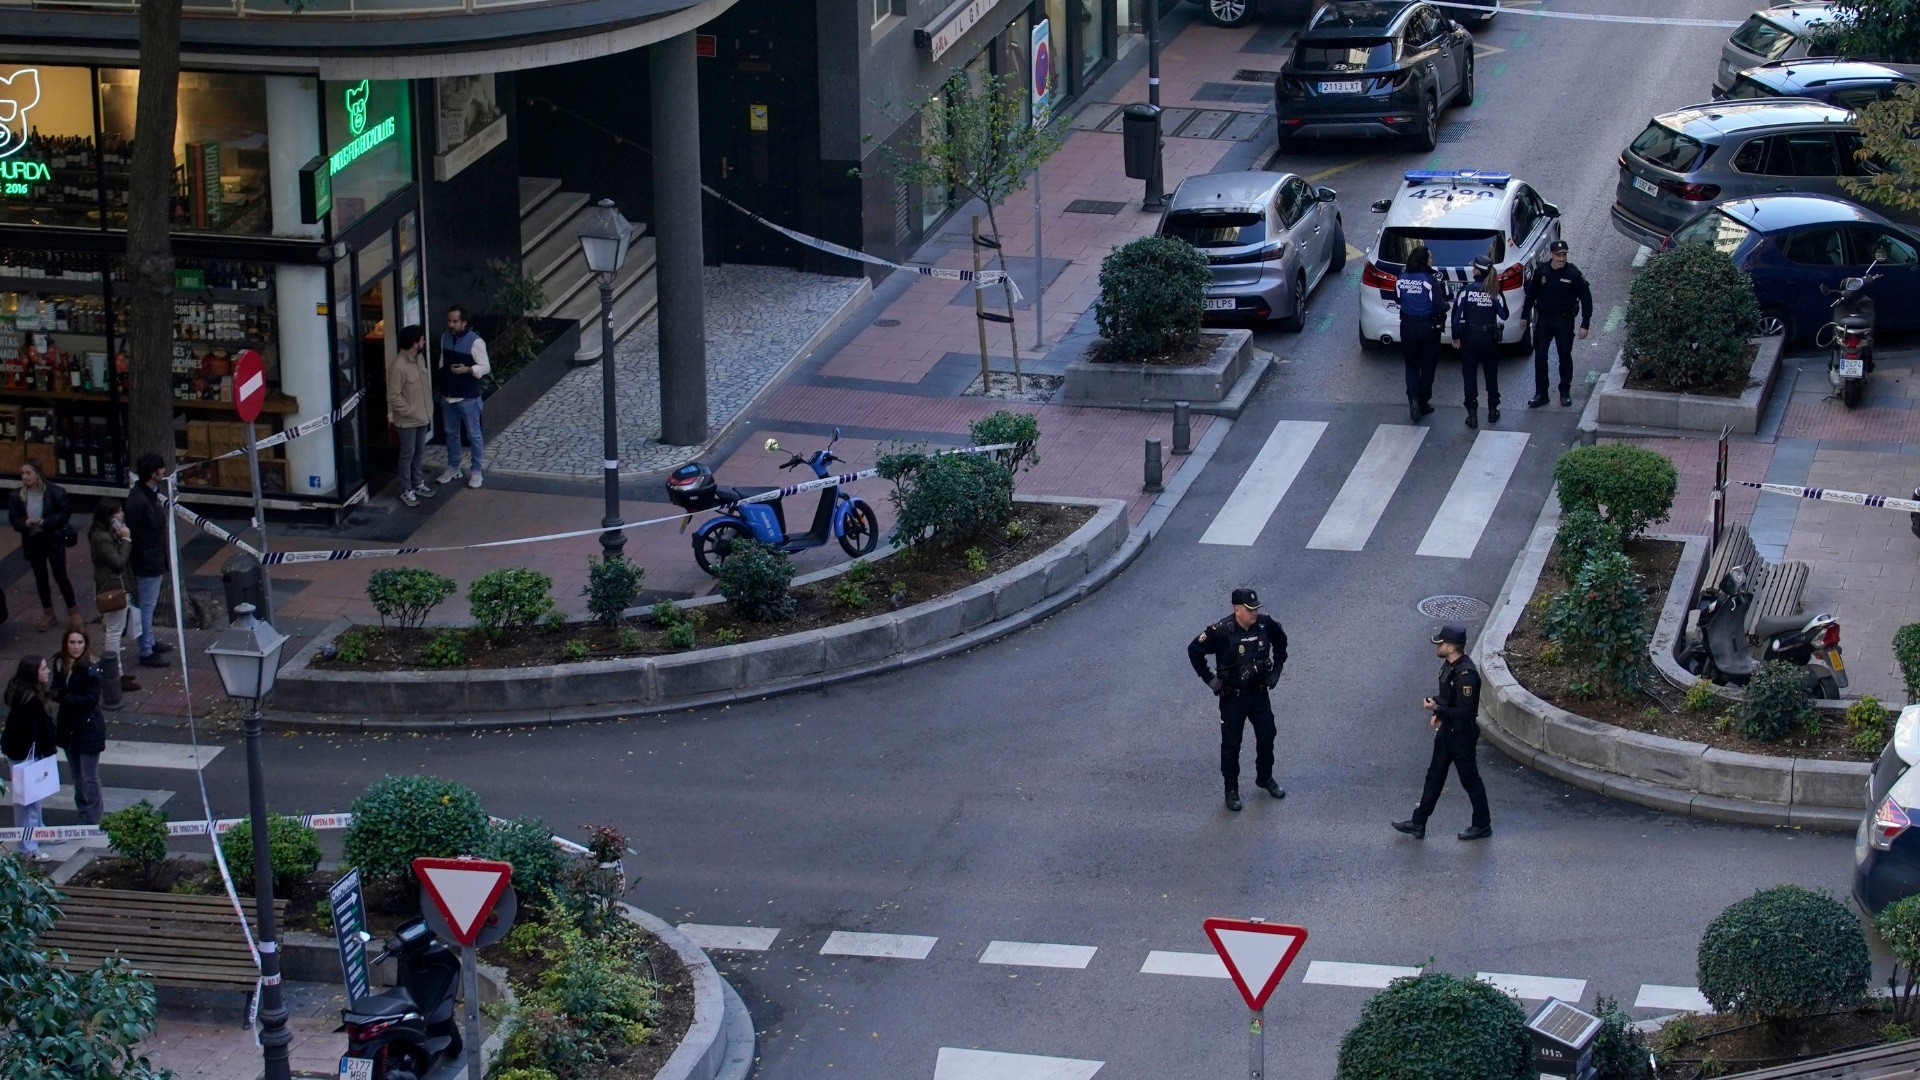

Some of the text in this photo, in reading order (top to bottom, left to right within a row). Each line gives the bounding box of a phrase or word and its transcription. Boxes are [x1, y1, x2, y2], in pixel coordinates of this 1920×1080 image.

[1323, 82, 1359, 91] 2113 LXT
[5, 183, 28, 194] 2016
[1216, 300, 1233, 309] LPS
[312, 818, 328, 827] PASAR
[1541, 1047, 1563, 1058] 015
[348, 1059, 372, 1070] 2177
